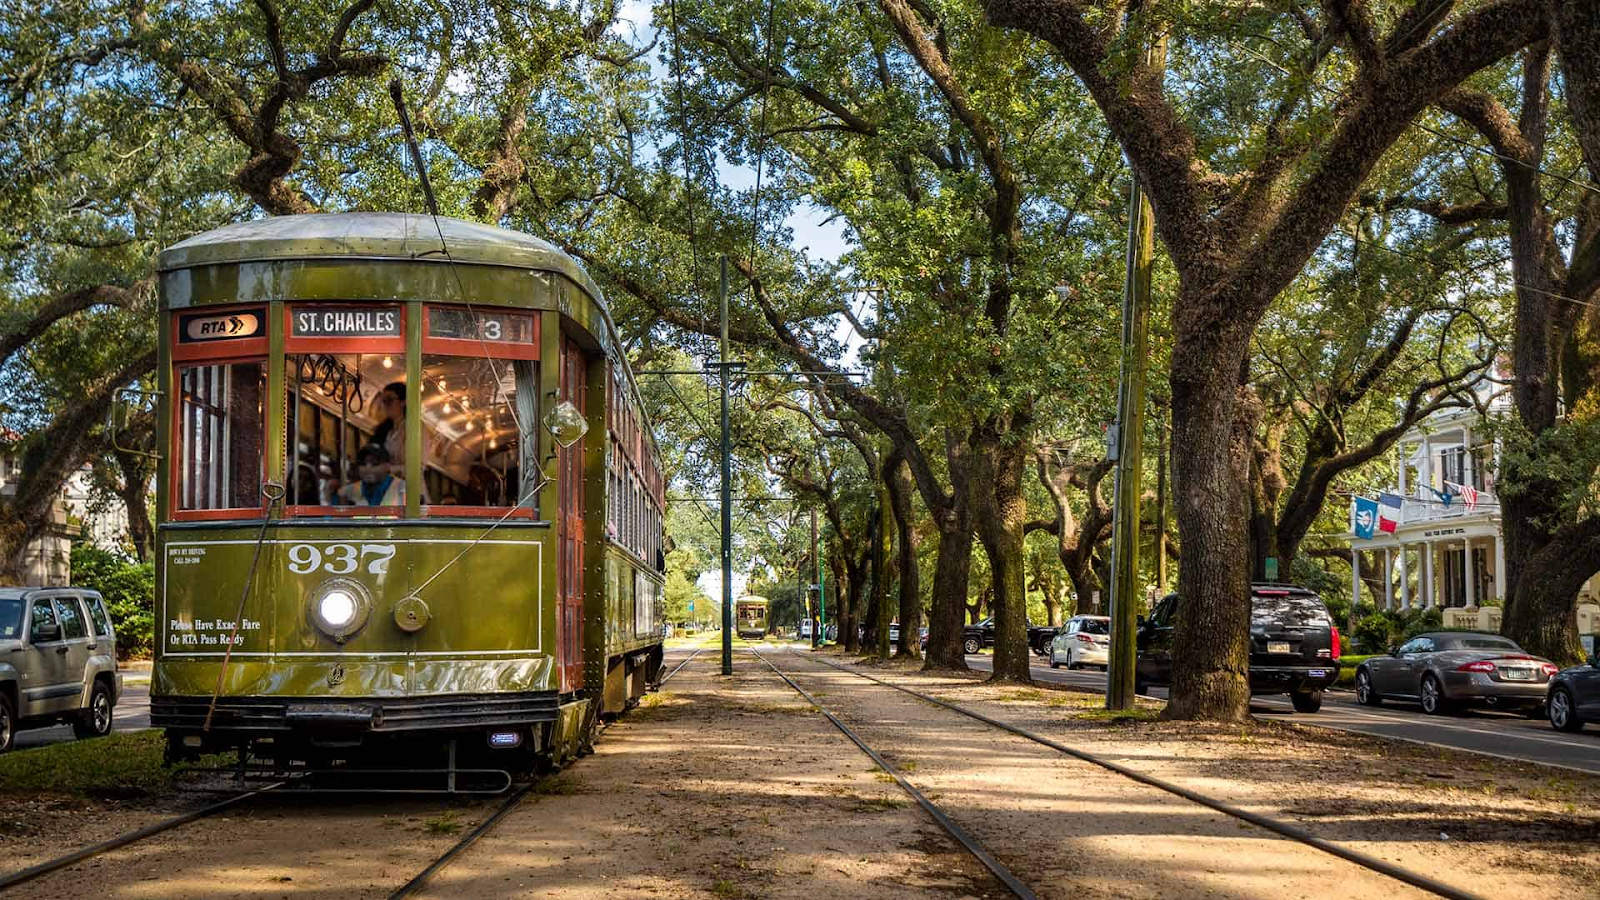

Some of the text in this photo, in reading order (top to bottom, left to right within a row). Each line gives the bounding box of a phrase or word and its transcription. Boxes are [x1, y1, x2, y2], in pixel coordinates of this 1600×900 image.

[201, 321, 227, 334] RTA
[299, 312, 395, 332] ST. CHARLES
[485, 320, 501, 340] 3
[288, 543, 396, 574] 937
[195, 619, 214, 630] Have
[216, 619, 239, 630] Exac
[242, 619, 260, 630] Fare
[170, 633, 244, 646] Or RTA Pass Redy
